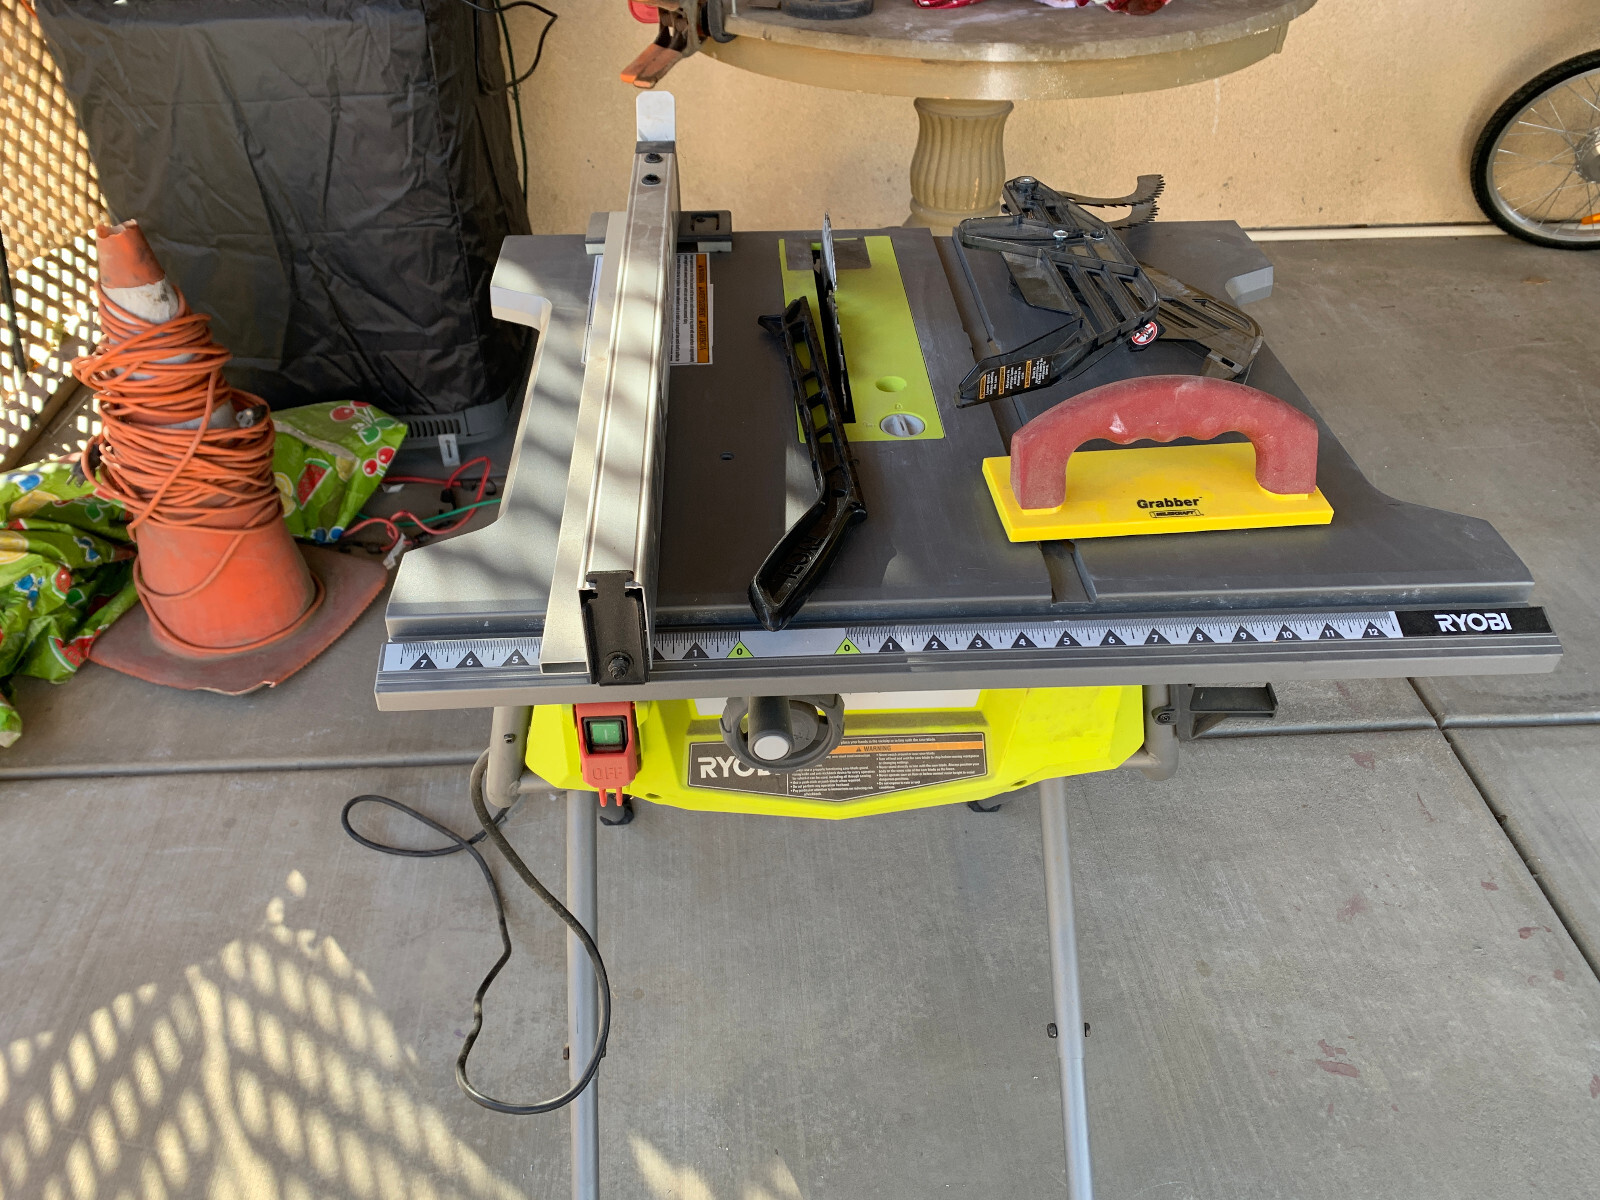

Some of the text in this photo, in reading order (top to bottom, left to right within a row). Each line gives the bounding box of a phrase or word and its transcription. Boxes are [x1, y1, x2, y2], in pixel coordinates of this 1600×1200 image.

[1136, 497, 1200, 509] Grabber
[1434, 612, 1513, 633] RYOBI
[419, 628, 1380, 668] 7 6 5 1 0 0 1 2 3 4 5 6 7 8 9 10 11 12
[592, 766, 623, 780] OFF
[697, 755, 781, 779] RYO
